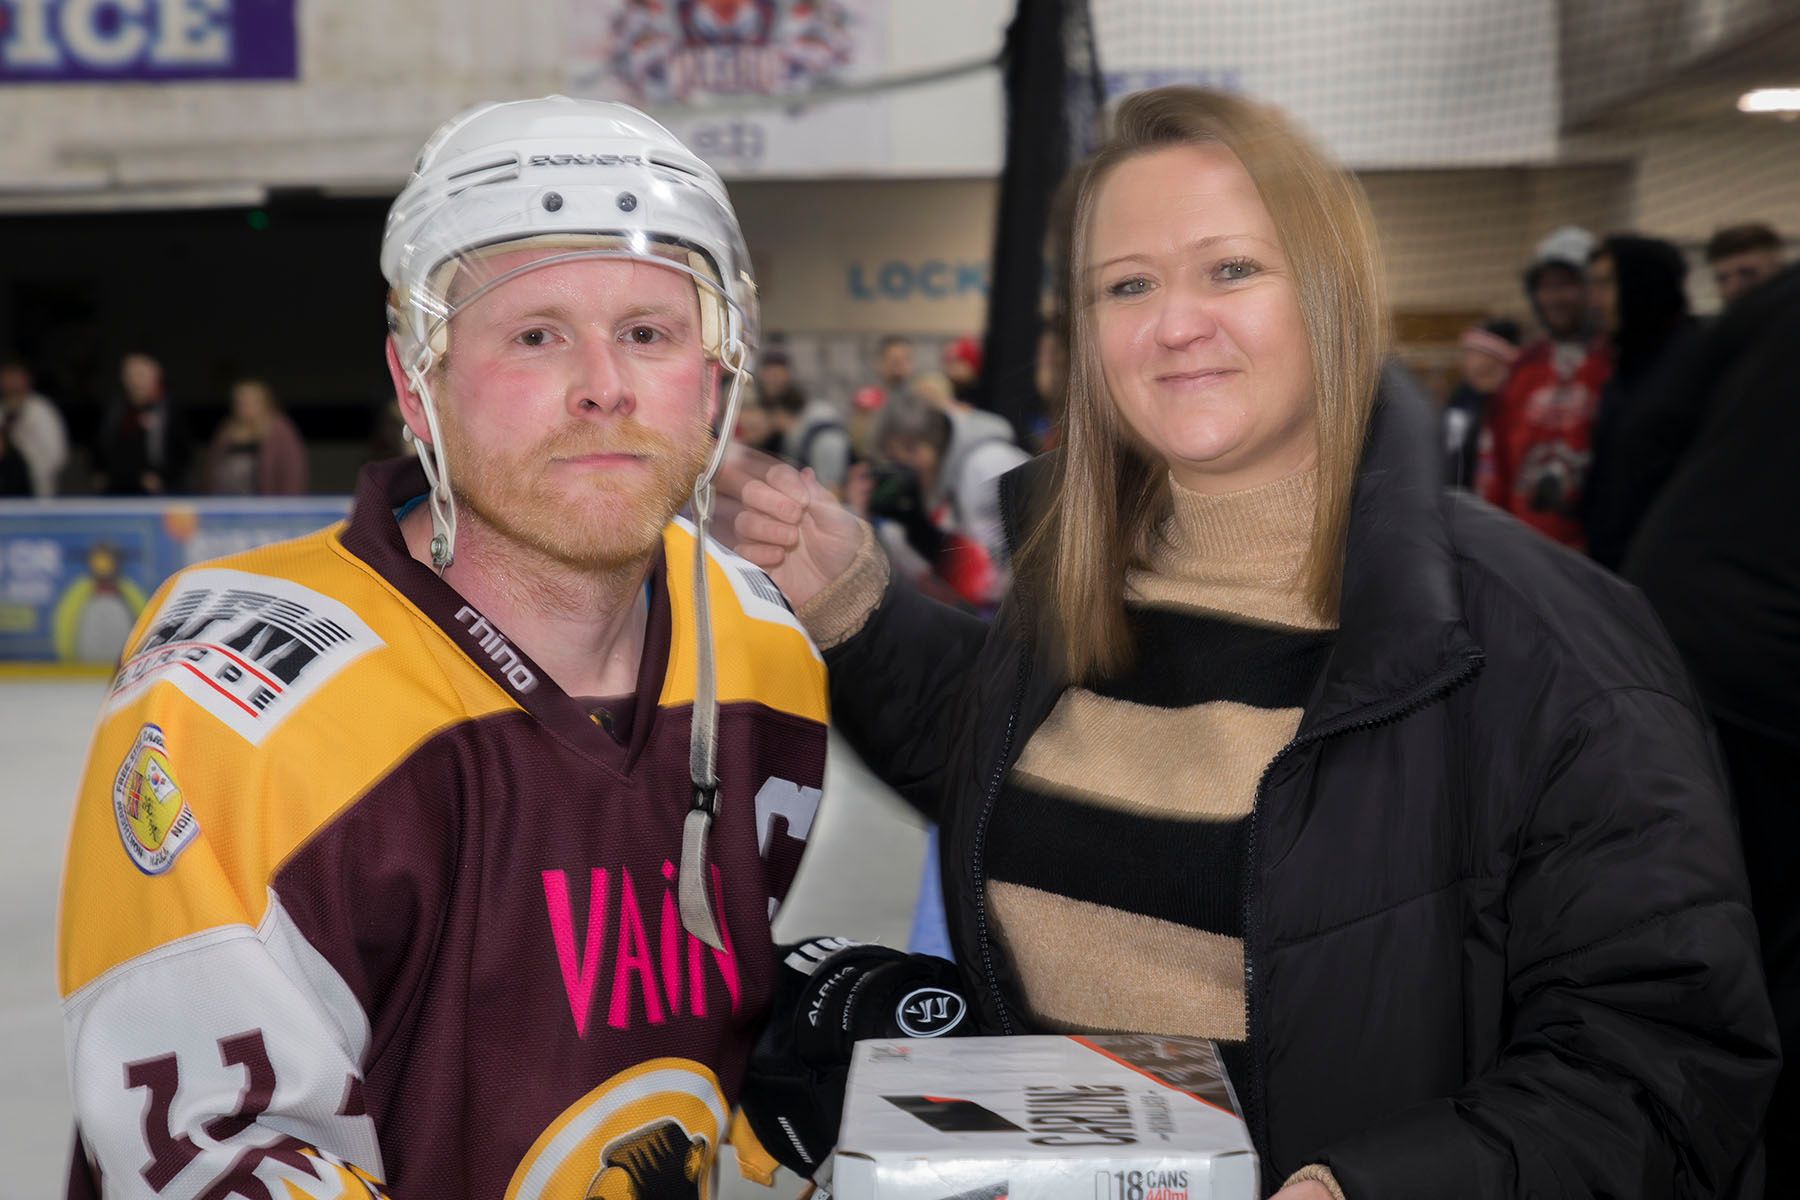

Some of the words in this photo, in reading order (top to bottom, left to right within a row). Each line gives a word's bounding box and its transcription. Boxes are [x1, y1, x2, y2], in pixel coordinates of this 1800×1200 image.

[3, 0, 236, 68] ICE
[847, 260, 998, 303] LOCK
[454, 606, 538, 694] rhino
[808, 966, 856, 1027] ALPHA
[1024, 1085, 1139, 1146] CARLING
[1113, 1170, 1144, 1200] 18
[1146, 1169, 1189, 1188] CANS
